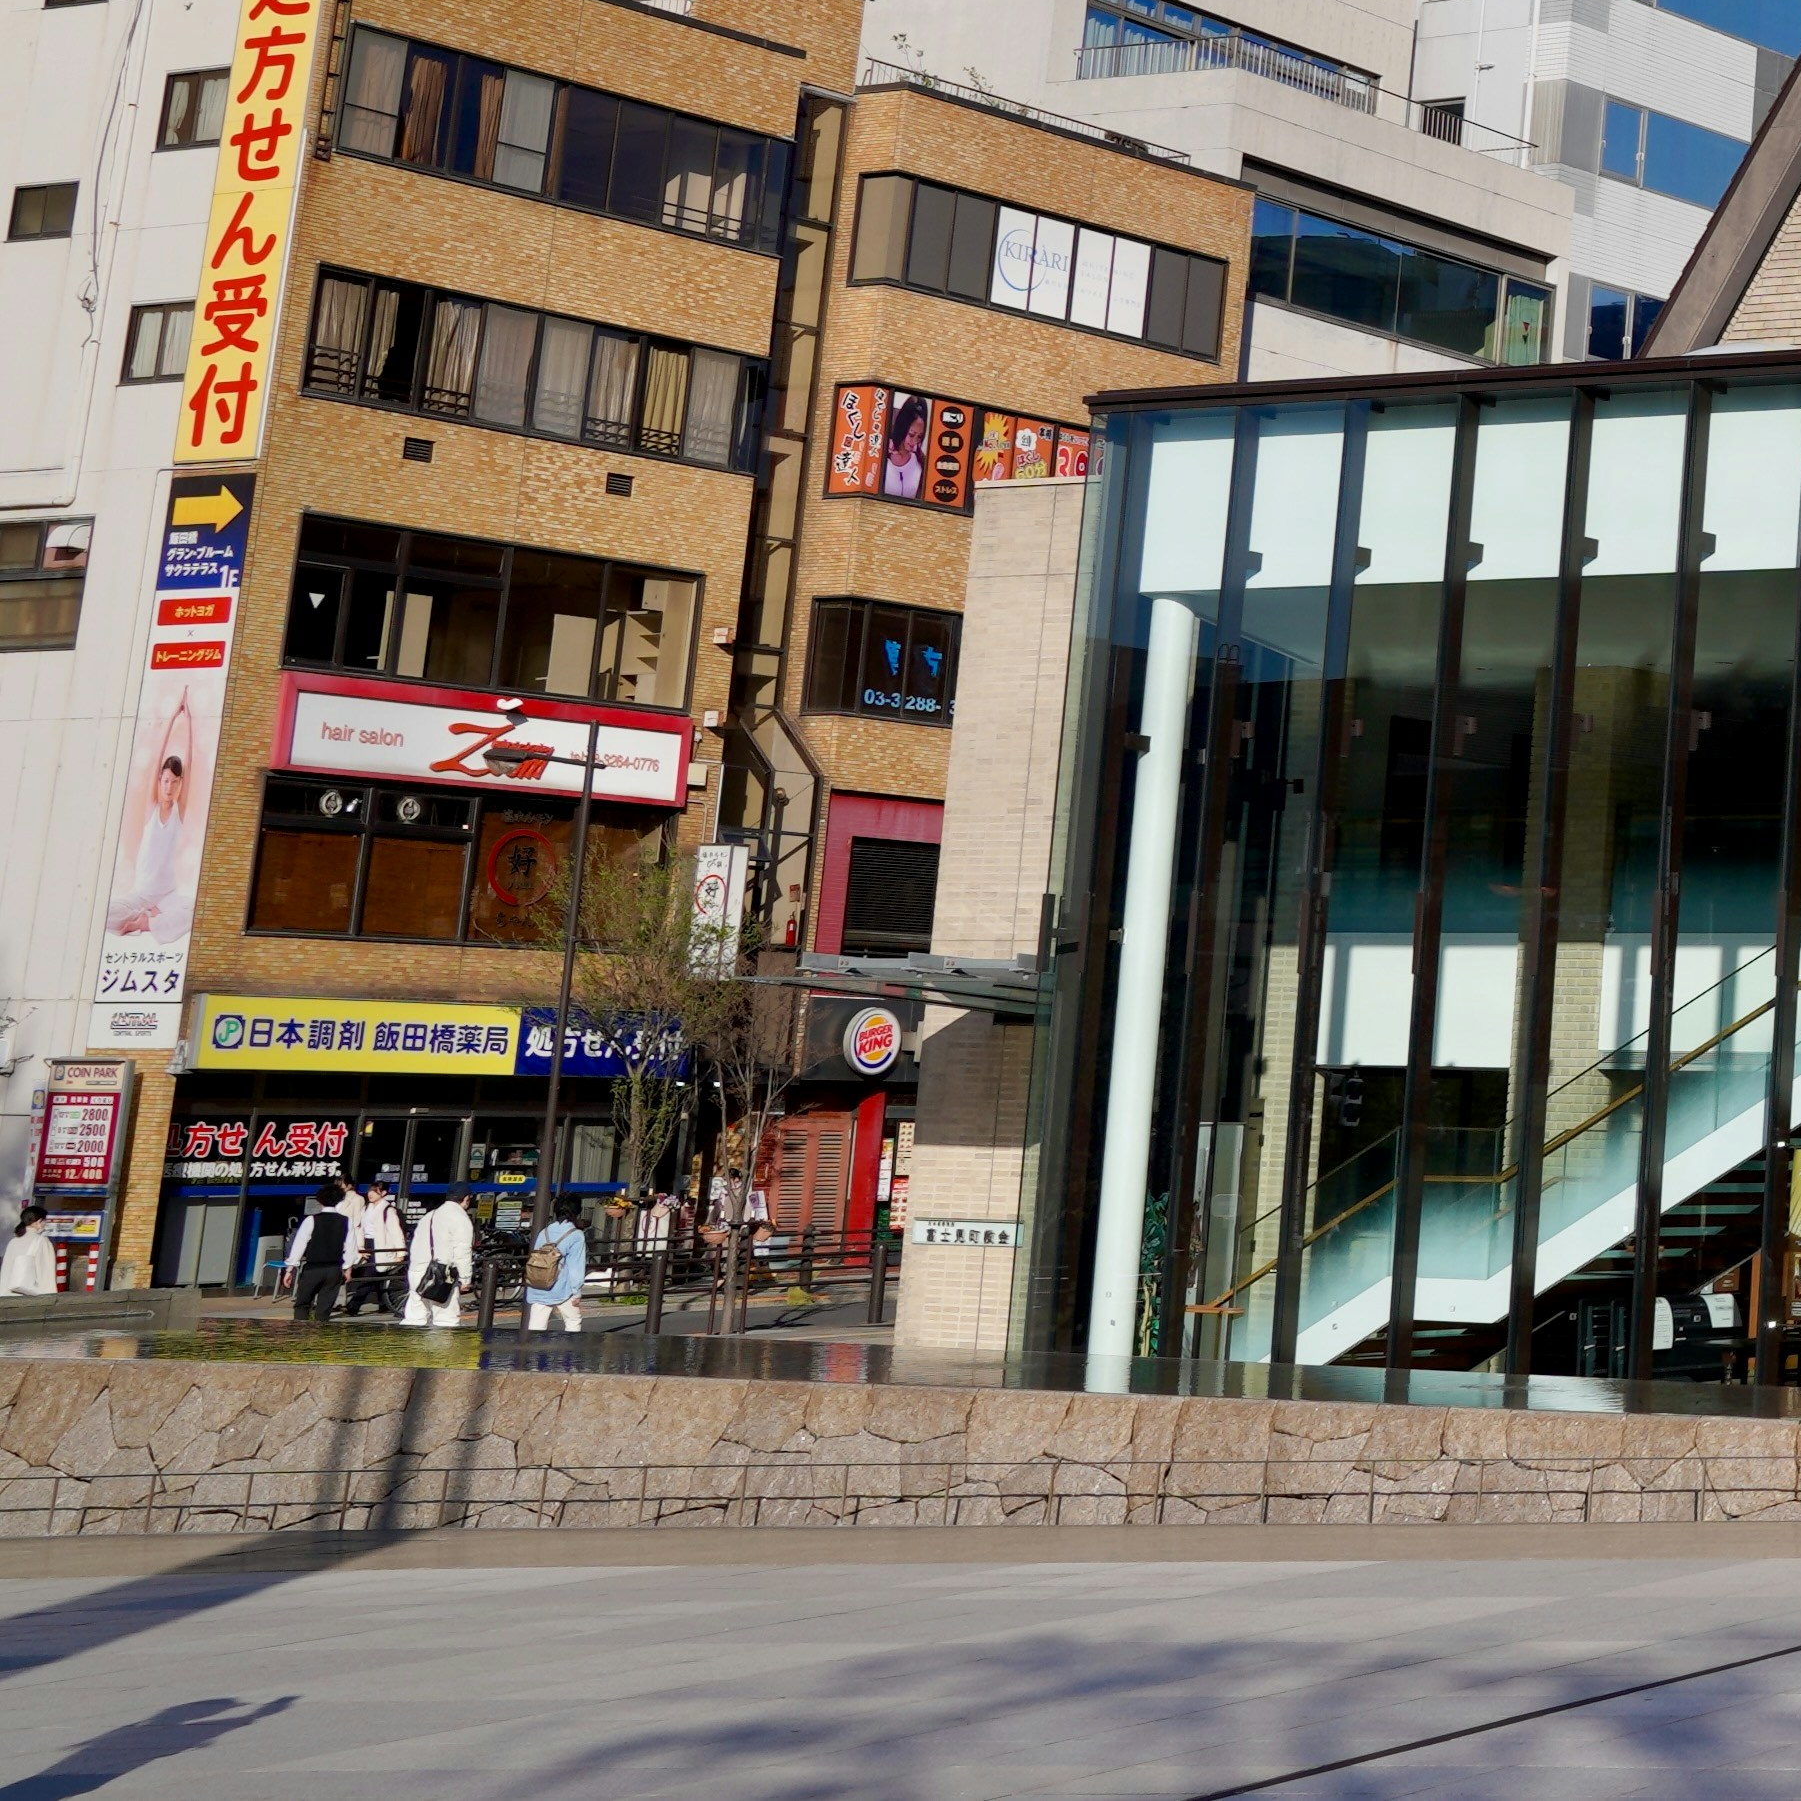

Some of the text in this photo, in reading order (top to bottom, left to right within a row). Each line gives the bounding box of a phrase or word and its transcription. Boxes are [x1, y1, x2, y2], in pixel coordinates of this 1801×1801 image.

[935, 485, 957, 495] ストレス
[165, 562, 218, 577] サクラテラス
[219, 565, 239, 588] 1F
[174, 604, 215, 618] ホットヨガ
[155, 648, 222, 665] トレーニングジム
[321, 721, 404, 747] hair salon
[508, 846, 537, 876] 好
[106, 952, 184, 964] セントラルスポーツ
[102, 969, 180, 994] ジムスタ
[248, 1017, 509, 1056] 日本調剤 飯田橋薬局
[859, 1024, 894, 1042] BURGER
[858, 1034, 893, 1057] KING
[67, 1066, 118, 1078] COIN PARK
[926, 1228, 1010, 1244] 富士見町教会
